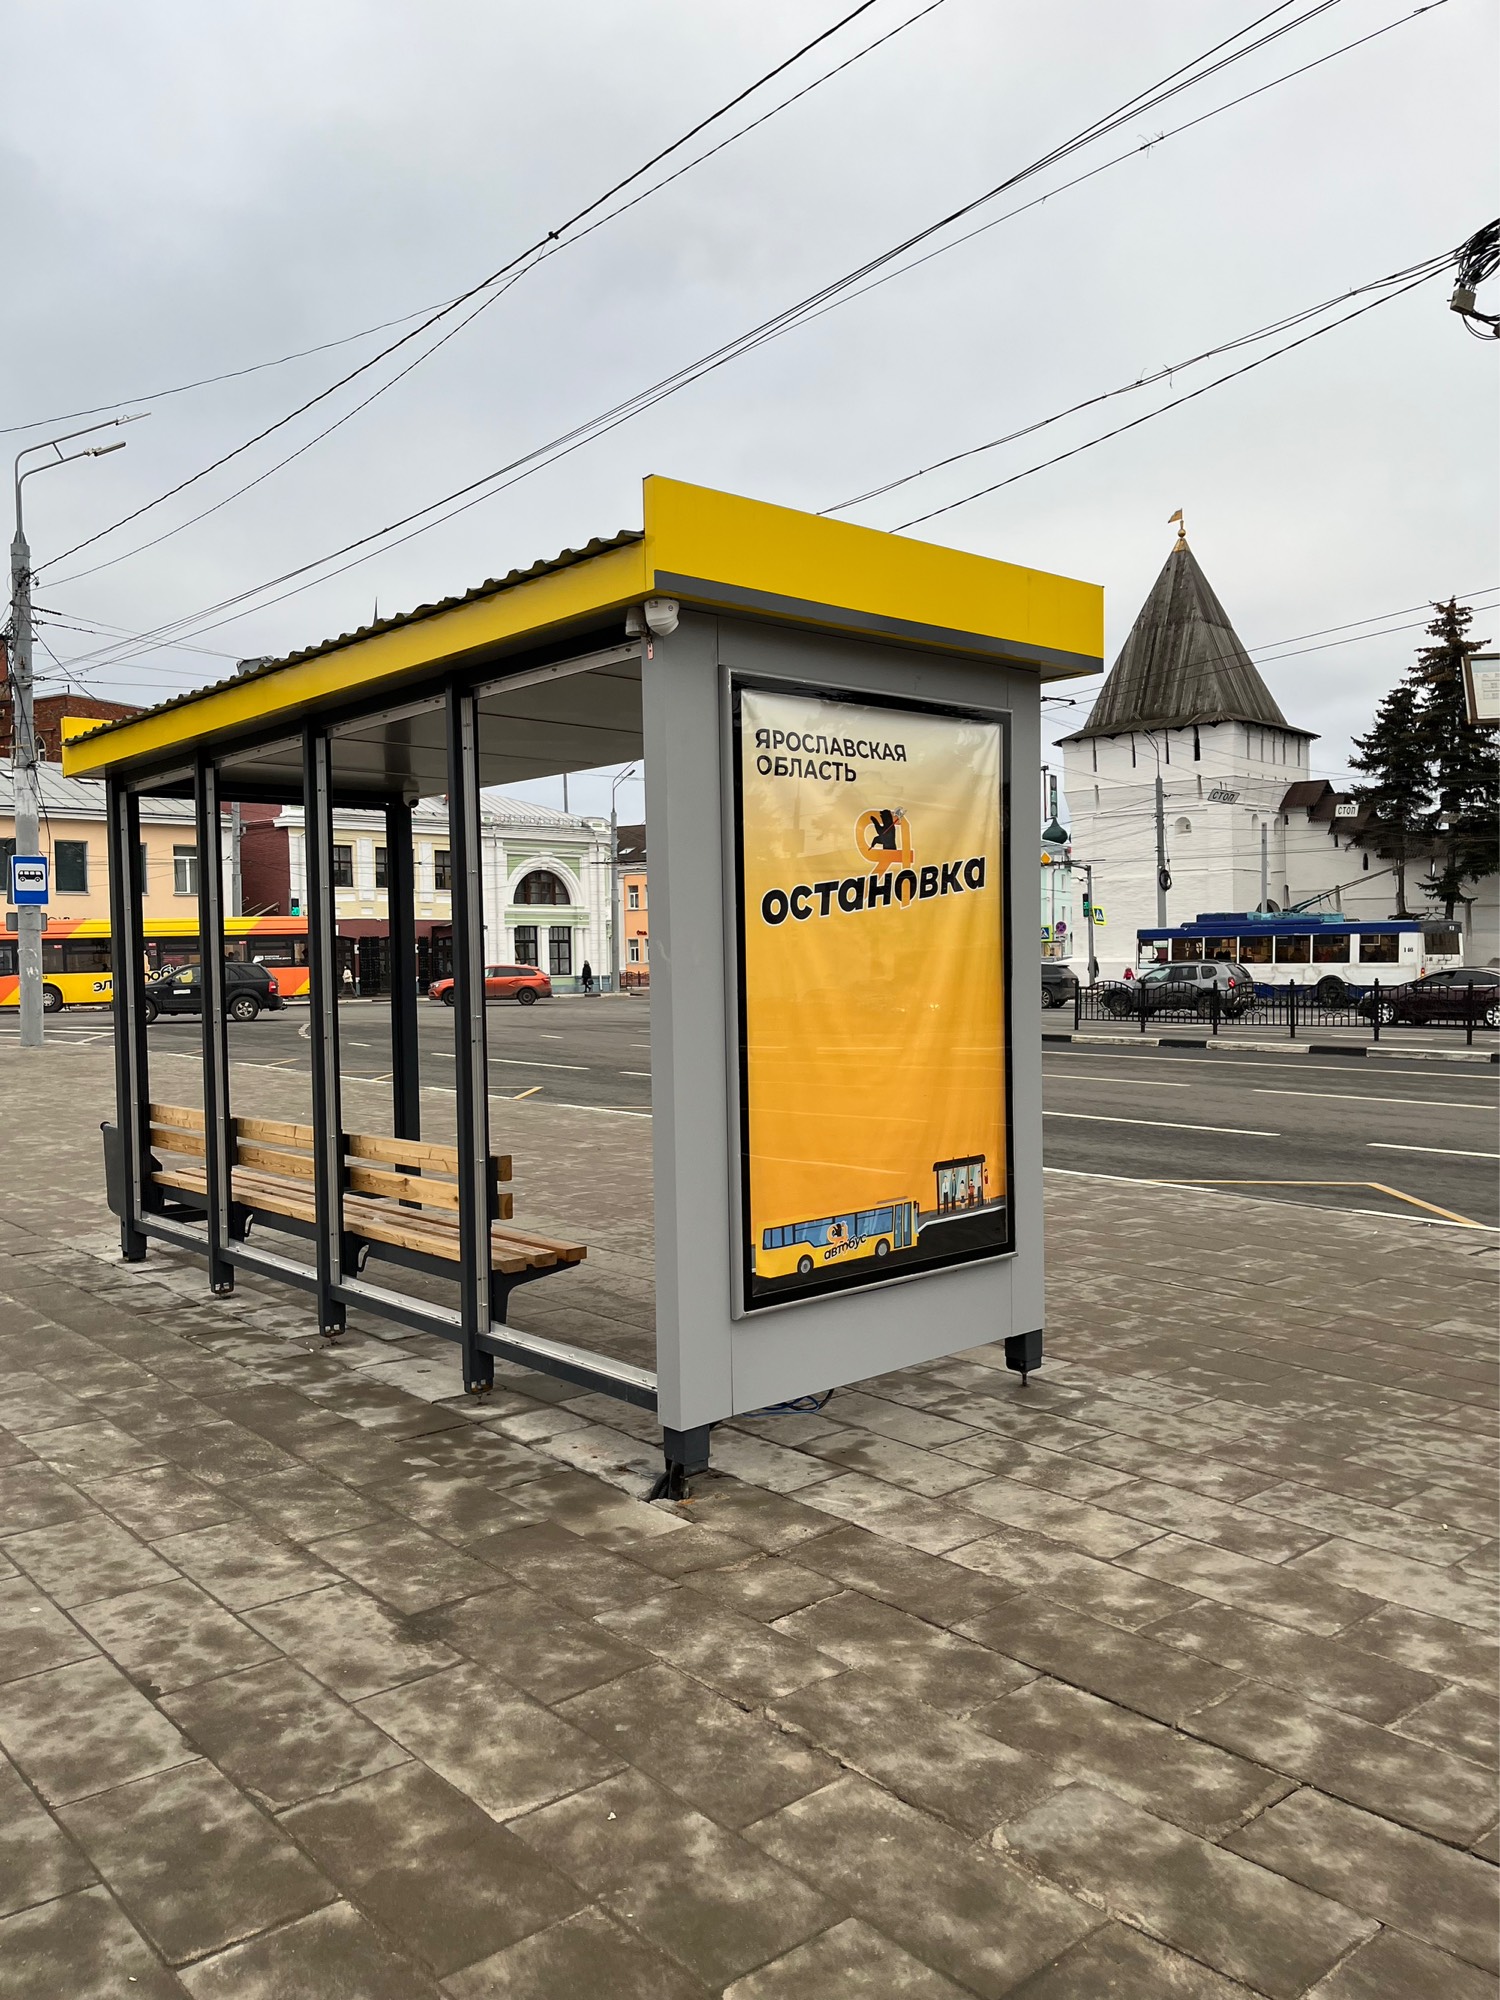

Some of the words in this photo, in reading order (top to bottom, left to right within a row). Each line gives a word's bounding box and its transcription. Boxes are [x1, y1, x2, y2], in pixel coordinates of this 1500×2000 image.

[755, 728, 907, 762] ЯРОСЛАВСКАЯ
[756, 754, 857, 782] ОБЛАСТЬ
[1212, 790, 1235, 802] СТОП
[1337, 805, 1356, 815] СТОП
